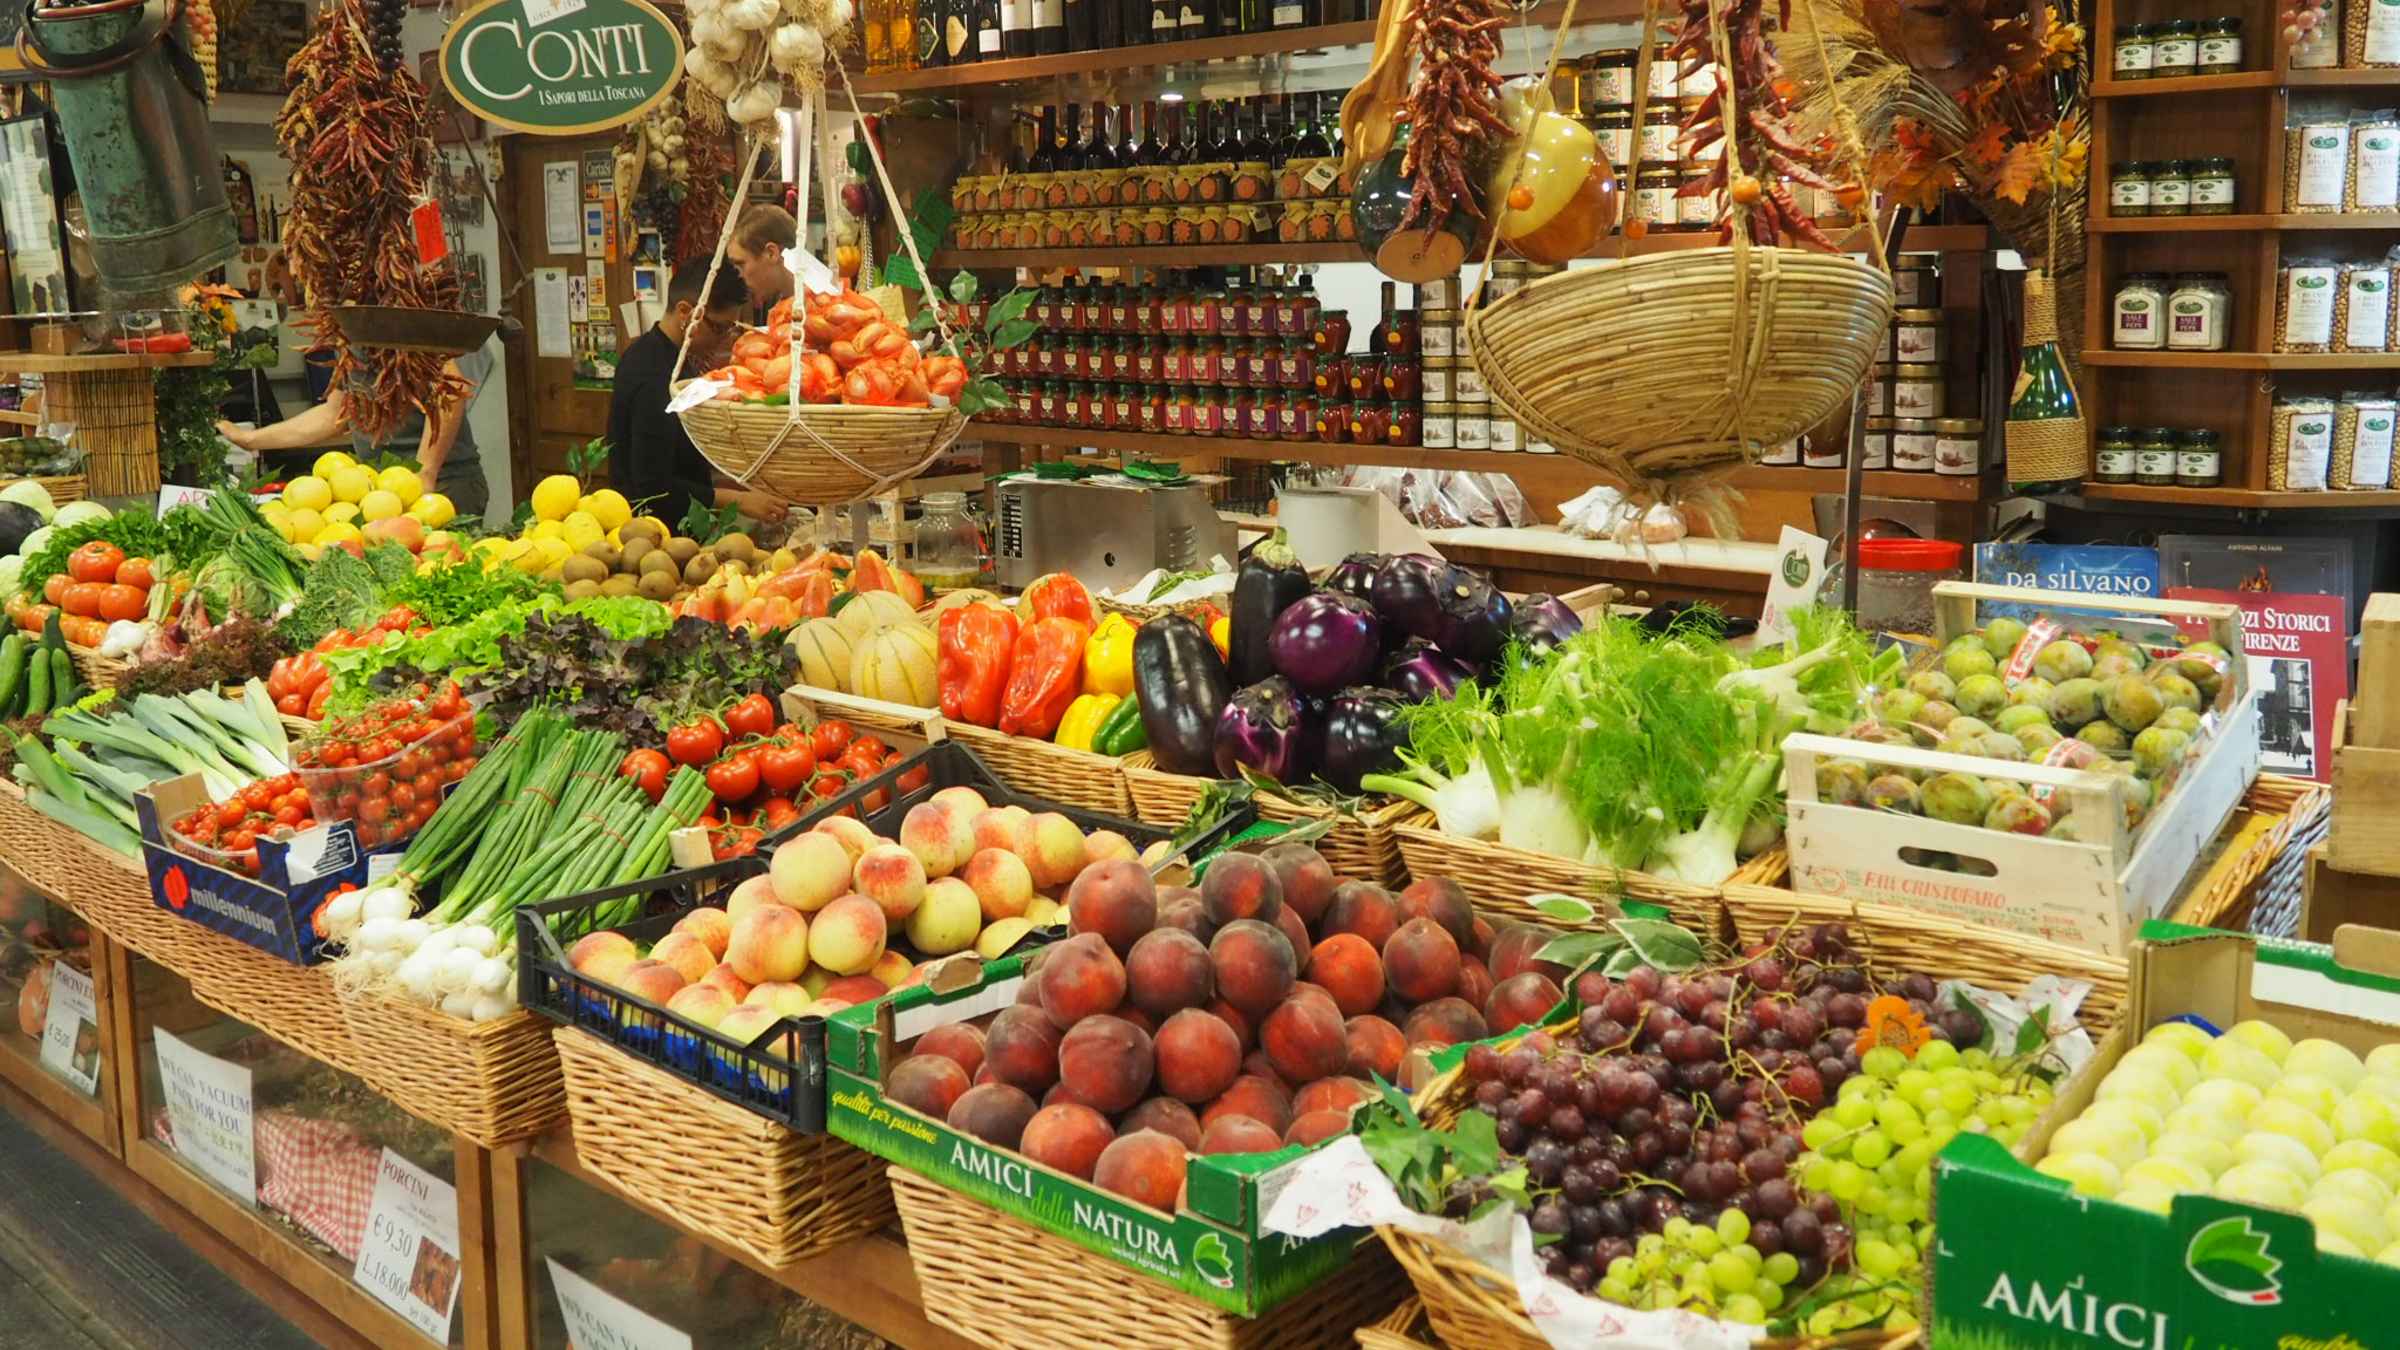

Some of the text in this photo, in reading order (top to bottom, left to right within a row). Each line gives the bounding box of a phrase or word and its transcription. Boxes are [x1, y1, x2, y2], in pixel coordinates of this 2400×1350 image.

[460, 18, 652, 100] CONTI
[546, 91, 577, 105] SAPORI
[577, 88, 605, 104] DELLA
[604, 84, 646, 101] TOSCANA
[2263, 607, 2331, 633] STORICI
[190, 887, 277, 936] millennium
[199, 1079, 250, 1116] VACUUM
[217, 1110, 242, 1135] YOU
[867, 1107, 890, 1124] per
[887, 1116, 938, 1145] passione
[383, 1158, 429, 1201] PORCINI
[950, 1139, 1033, 1199] AMICI
[1072, 1199, 1181, 1266] NATURA
[373, 1212, 383, 1237] €
[385, 1219, 413, 1258] 9,30
[1981, 1271, 2169, 1350] AMICI
